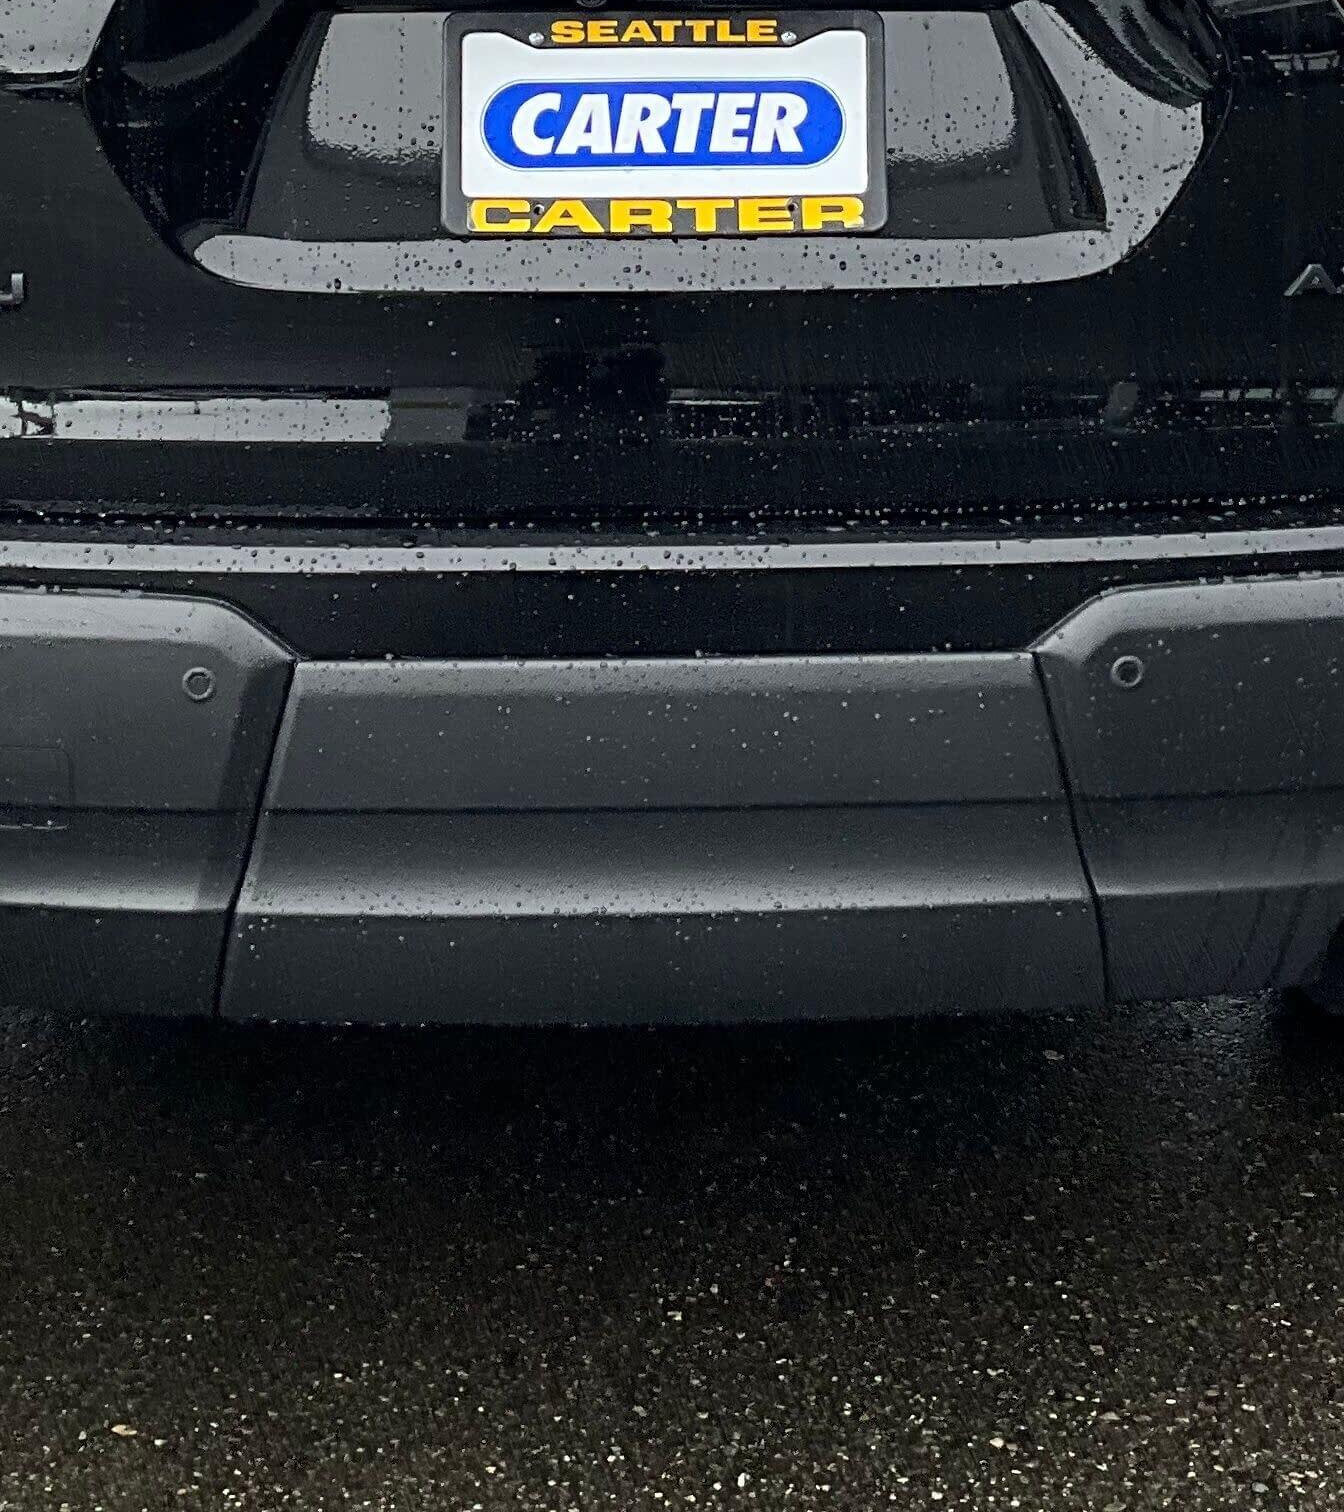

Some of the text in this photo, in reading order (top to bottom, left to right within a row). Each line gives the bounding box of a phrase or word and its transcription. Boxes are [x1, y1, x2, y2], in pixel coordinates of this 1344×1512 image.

[550, 19, 779, 43] SEATTLE
[511, 92, 809, 156] CARTER
[470, 198, 865, 234] CARTER
